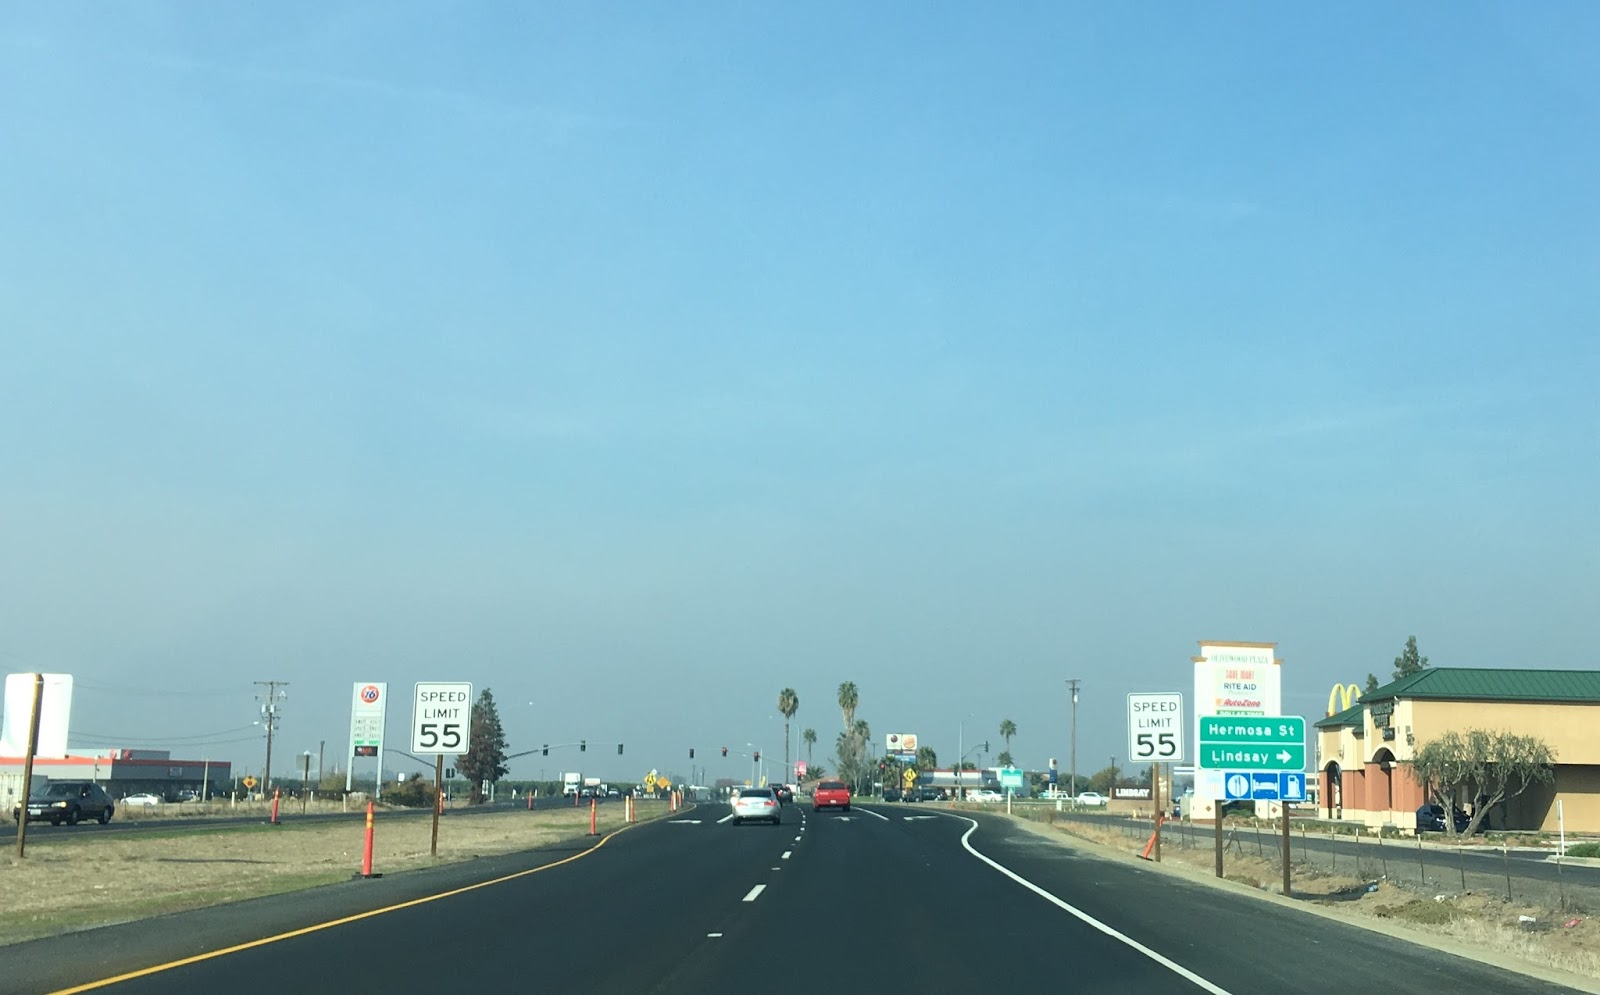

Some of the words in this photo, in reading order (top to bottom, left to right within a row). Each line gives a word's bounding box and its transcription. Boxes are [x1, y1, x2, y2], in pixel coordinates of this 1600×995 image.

[1223, 682, 1242, 690] RITE
[1243, 683, 1257, 691] AID
[420, 691, 466, 702] SPEED
[1133, 701, 1177, 712] SPEED
[1223, 698, 1261, 707] AutoZone
[424, 708, 460, 719] LIMIT
[1138, 717, 1172, 728] LIMIT
[1208, 723, 1272, 736] Hermosa
[1279, 725, 1294, 736] St
[420, 723, 461, 748] 55
[1137, 733, 1176, 757] 55
[1211, 750, 1269, 764] Lindsay
[1115, 788, 1150, 798] LINDSAY
